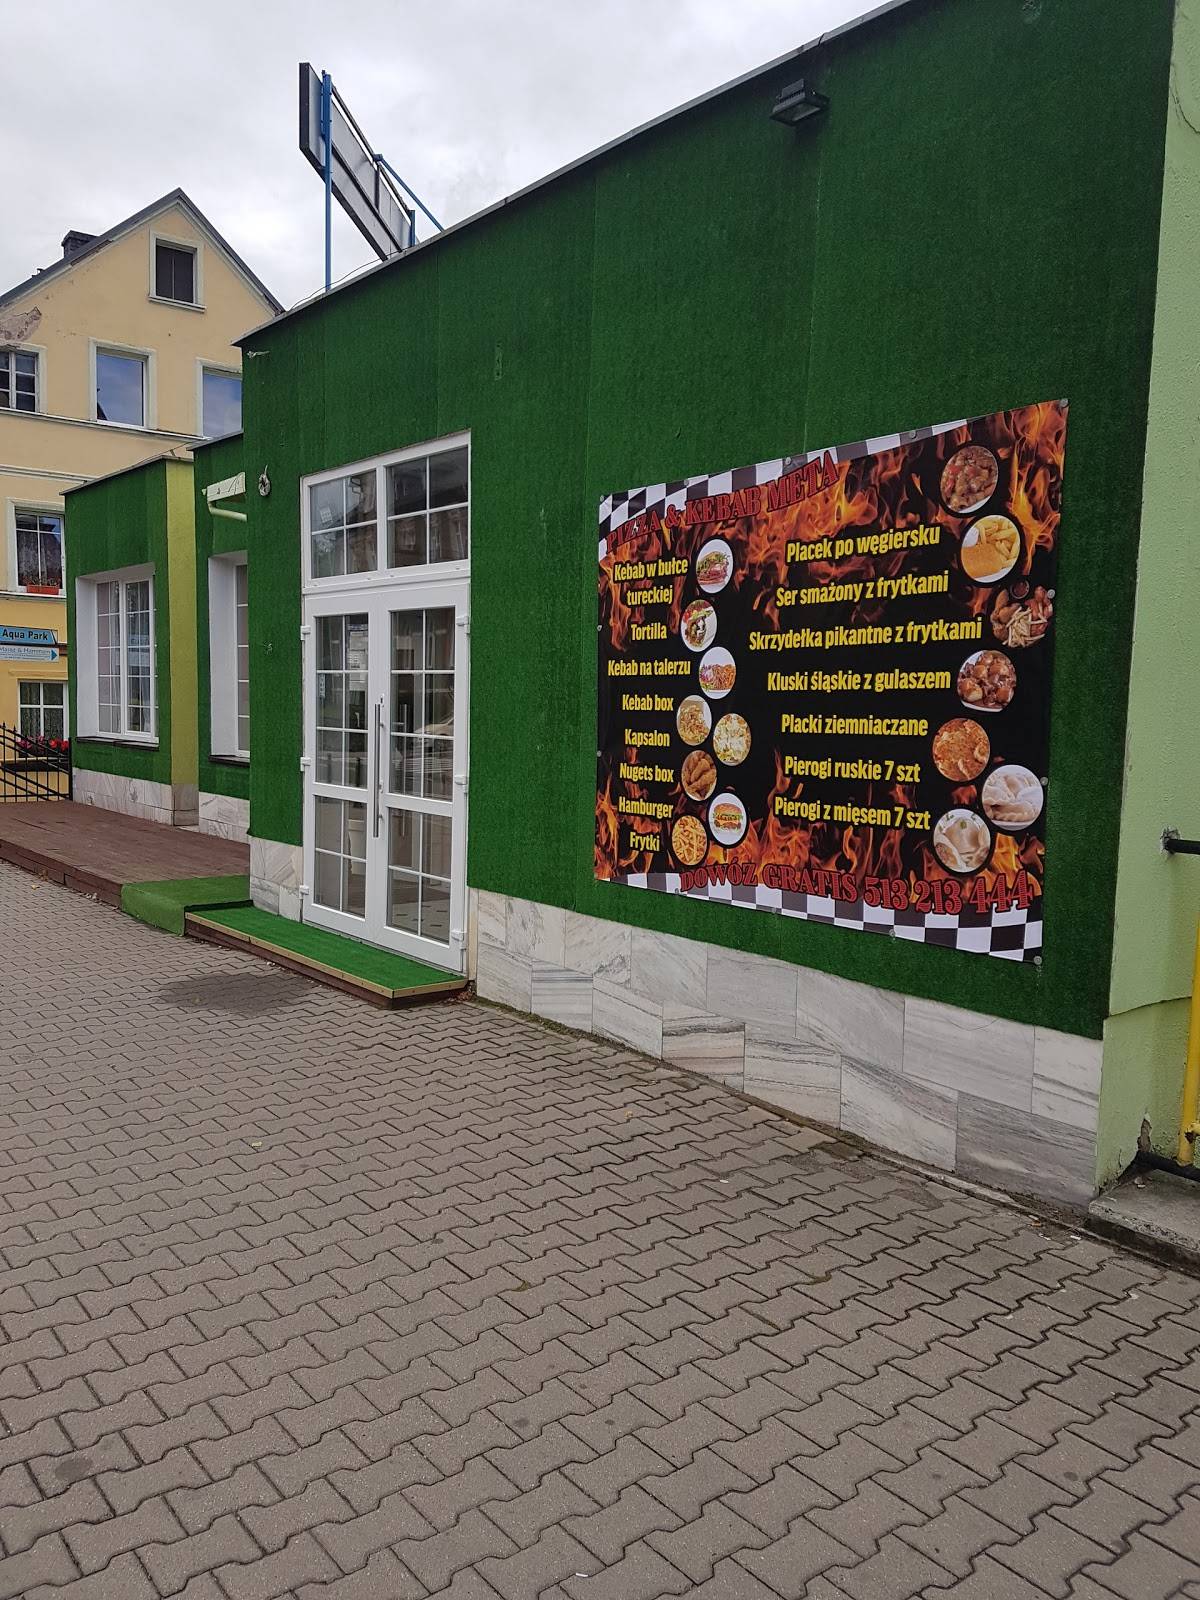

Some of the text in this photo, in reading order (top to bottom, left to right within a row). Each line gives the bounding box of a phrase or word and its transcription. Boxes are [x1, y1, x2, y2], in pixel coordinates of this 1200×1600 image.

[606, 450, 839, 553] PIZZA & KEBAB META
[787, 524, 941, 562] Placek po węgiersku
[614, 558, 689, 581] Kebab w bułce
[626, 585, 673, 606] tureckiej
[776, 570, 949, 607] Ser smażony z frytkami
[2, 628, 48, 640] Aqua Park
[631, 622, 667, 641] Tortilla
[750, 617, 983, 652] Skrzydełka pikantne z frytkami
[608, 659, 691, 676] Kebab na talerzu
[768, 669, 951, 693] Kluski śląskie z gulaszem
[622, 695, 674, 711] Kebab box
[781, 713, 929, 736] Placki ziemniaczane
[625, 729, 670, 747] Kapsalon
[620, 763, 674, 782] Nugets box
[785, 756, 921, 783] Pierogi ruskie 7 szt
[619, 797, 674, 819] Hamburger
[775, 797, 931, 831] Pierogi z mięsem 7 szt
[629, 832, 660, 851] Frytki
[680, 857, 1033, 914] DOWÓZ GRATIS 513 213 444
